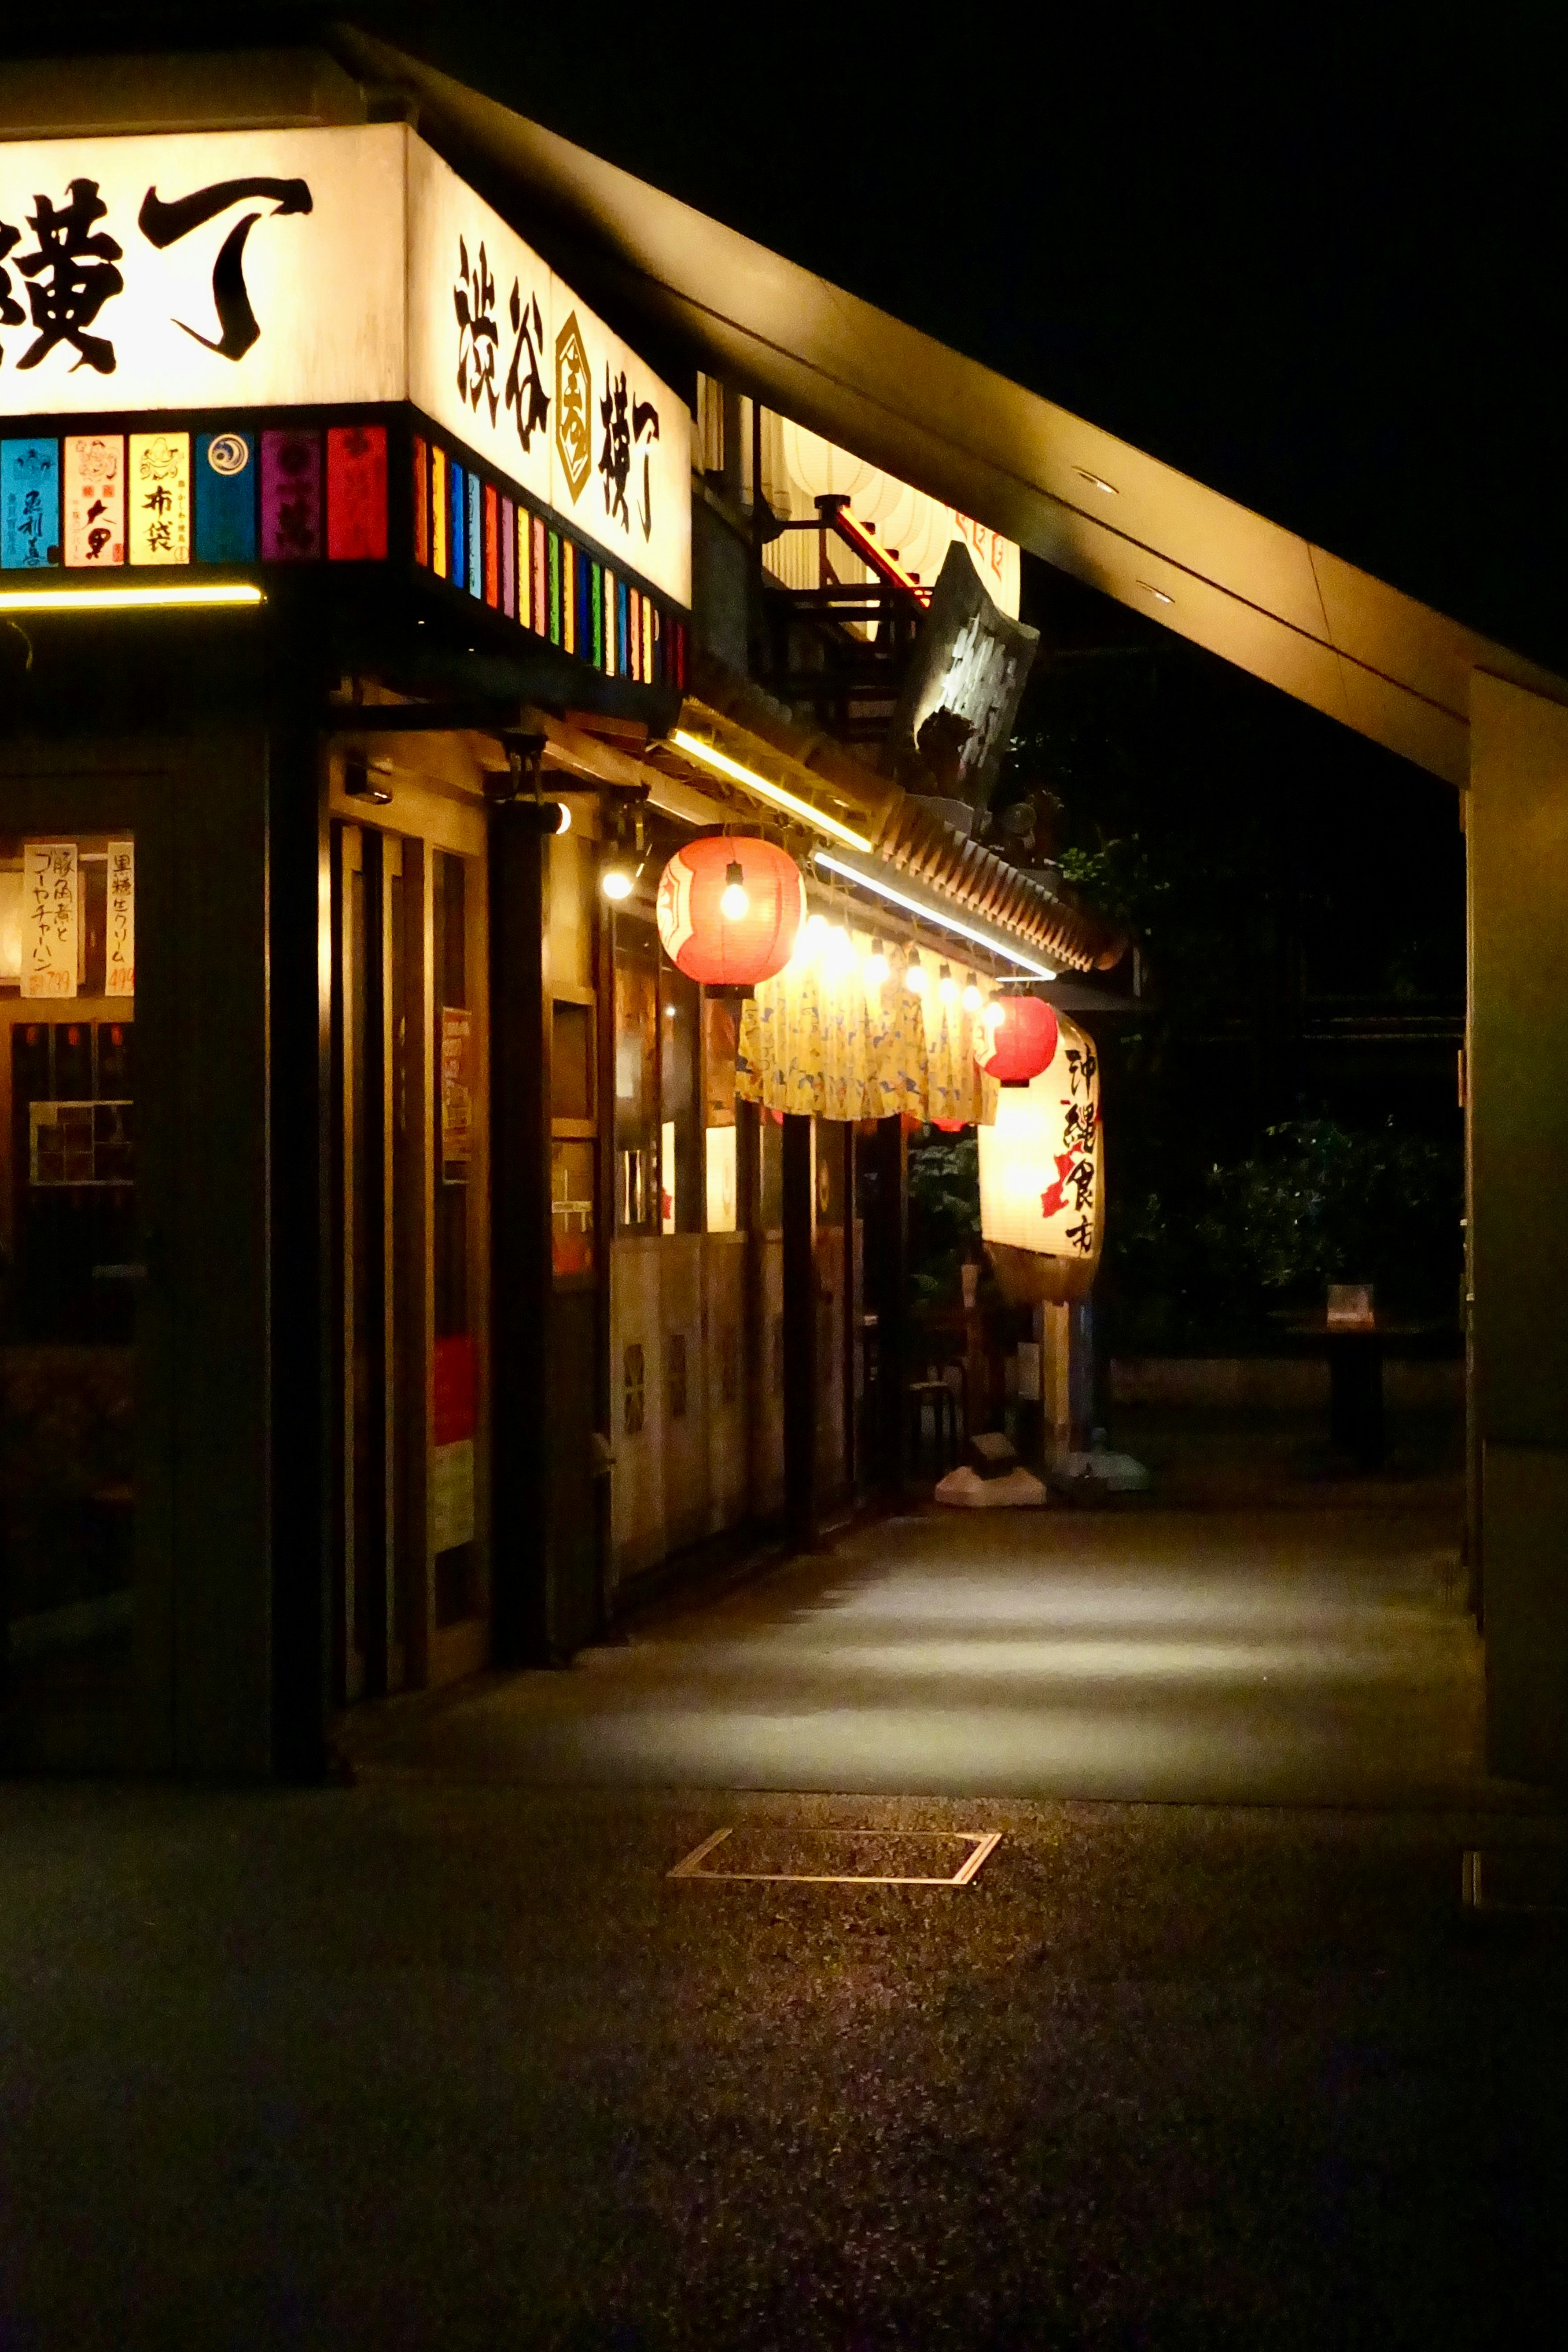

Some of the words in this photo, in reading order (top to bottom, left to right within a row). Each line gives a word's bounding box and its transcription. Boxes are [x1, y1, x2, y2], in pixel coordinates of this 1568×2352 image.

[141, 485, 175, 553] 布袋
[598, 360, 659, 544] 横丁
[31, 849, 56, 971] ゴーヤチャーハン
[1063, 1043, 1095, 1253] 沖縄食市
